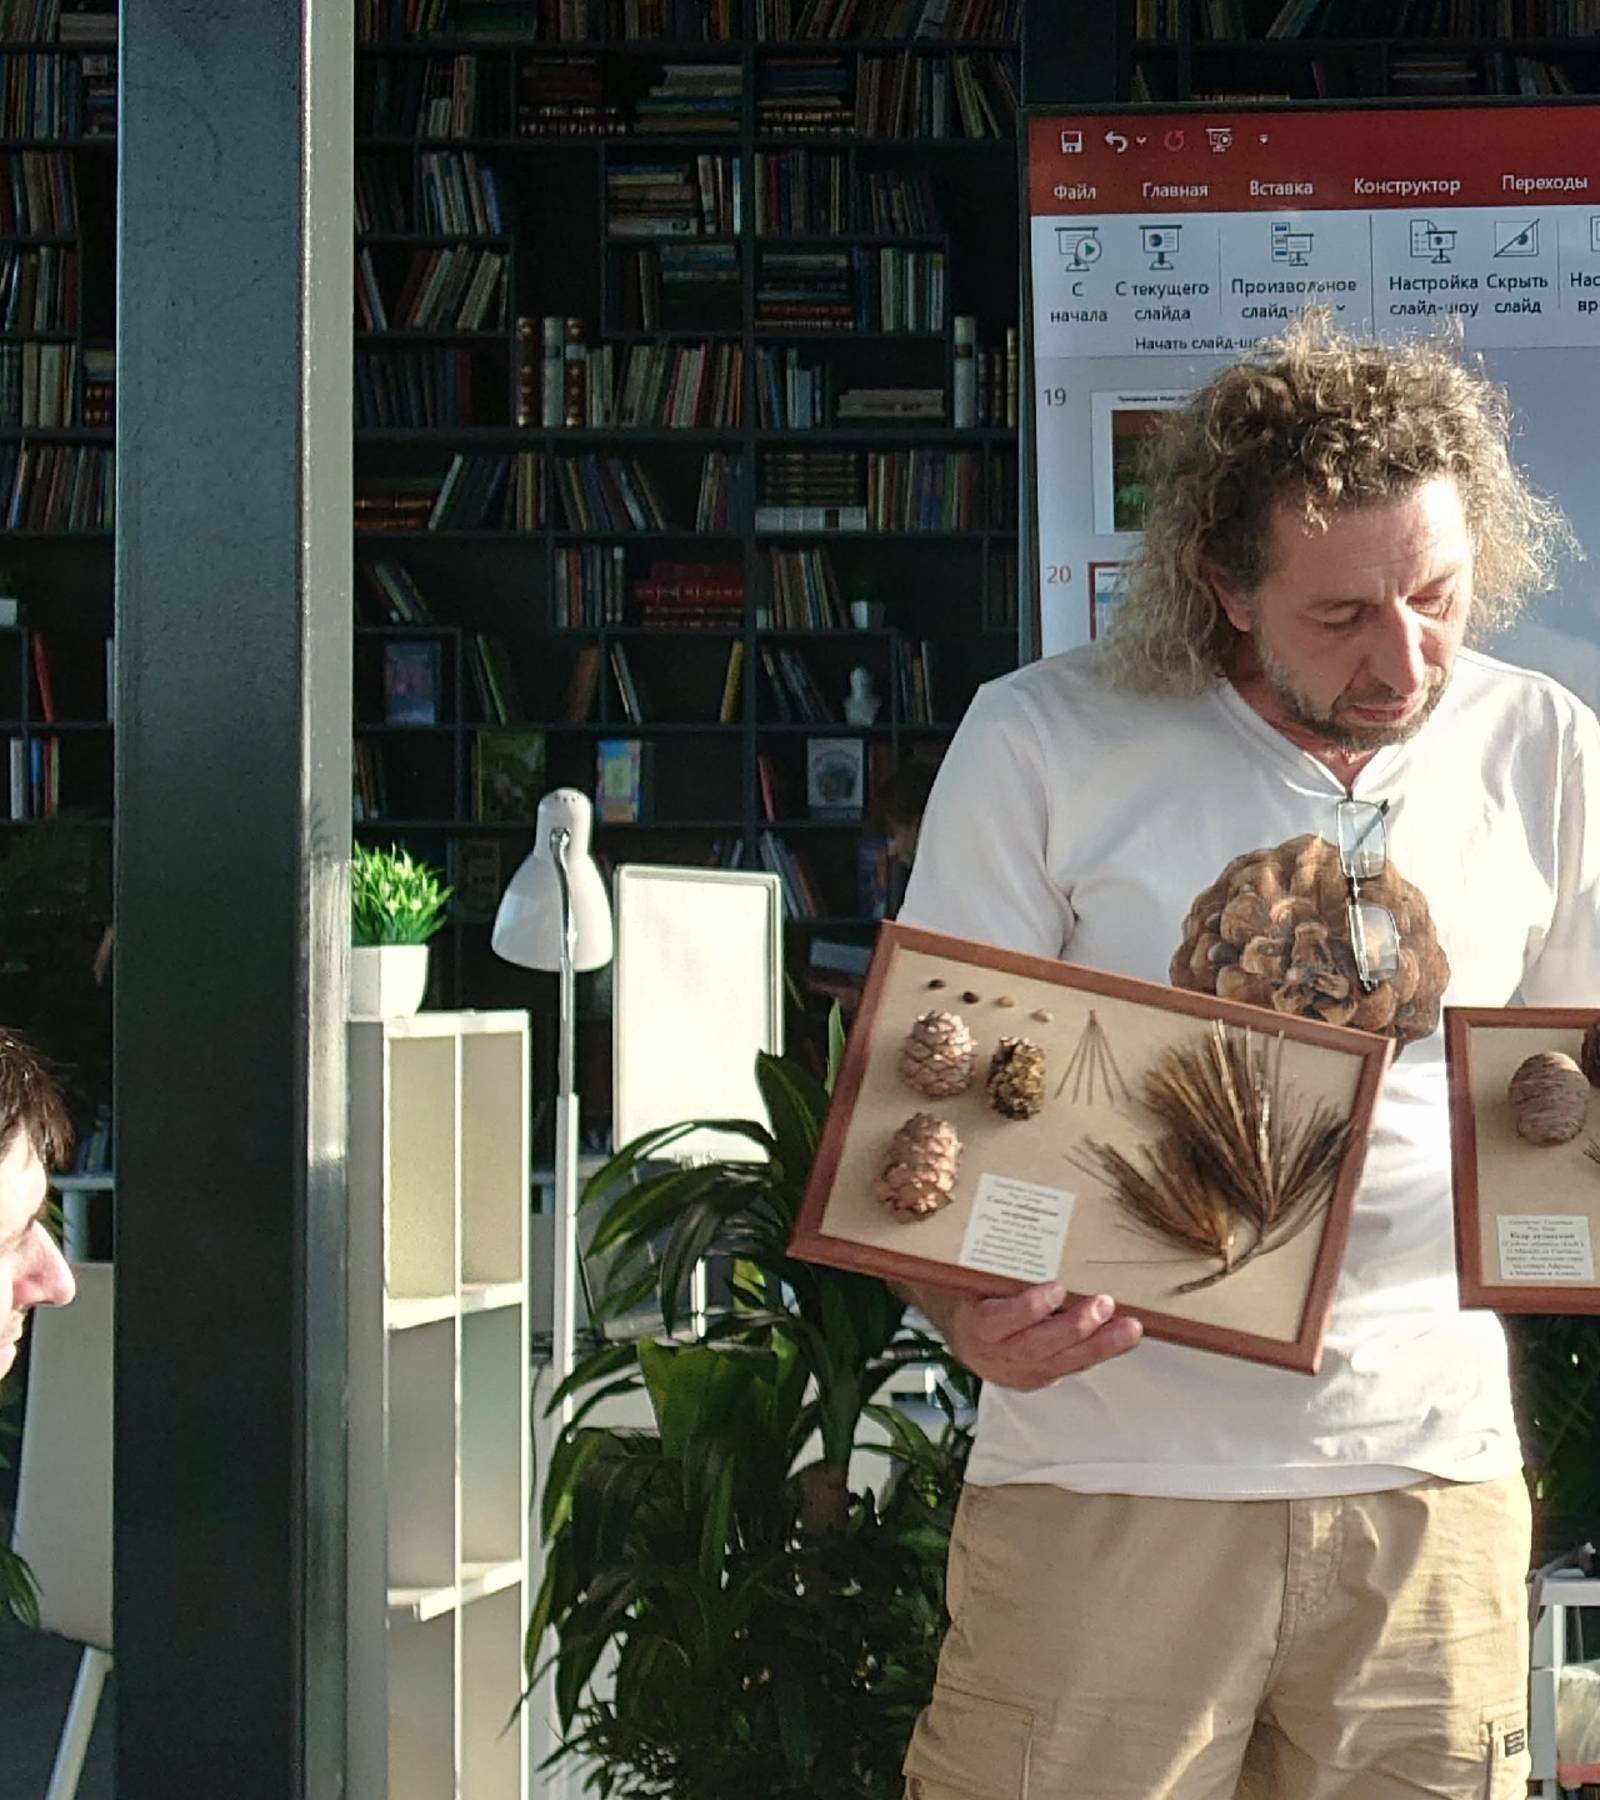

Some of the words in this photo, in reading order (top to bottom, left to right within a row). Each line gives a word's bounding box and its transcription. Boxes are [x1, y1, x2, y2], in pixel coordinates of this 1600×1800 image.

[1053, 182, 1097, 200] Файл
[1142, 182, 1209, 198] Главная
[1249, 180, 1314, 196] Вставка
[1353, 177, 1462, 196] Конструктор
[1502, 174, 1589, 193] Переходы
[1071, 281, 1084, 297] С
[1115, 281, 1128, 297] С
[1131, 281, 1209, 297] текущего
[1231, 278, 1357, 296] Произвольное
[1389, 274, 1479, 293] Настройка
[1486, 274, 1549, 292] Скрыть
[1050, 308, 1108, 323] начала
[1135, 307, 1191, 322] слайда
[1389, 299, 1479, 319] слайд-шоу
[1494, 299, 1542, 317] слайд
[1135, 337, 1188, 351] Начать
[1043, 387, 1067, 407] 19
[1047, 565, 1072, 585] 20
